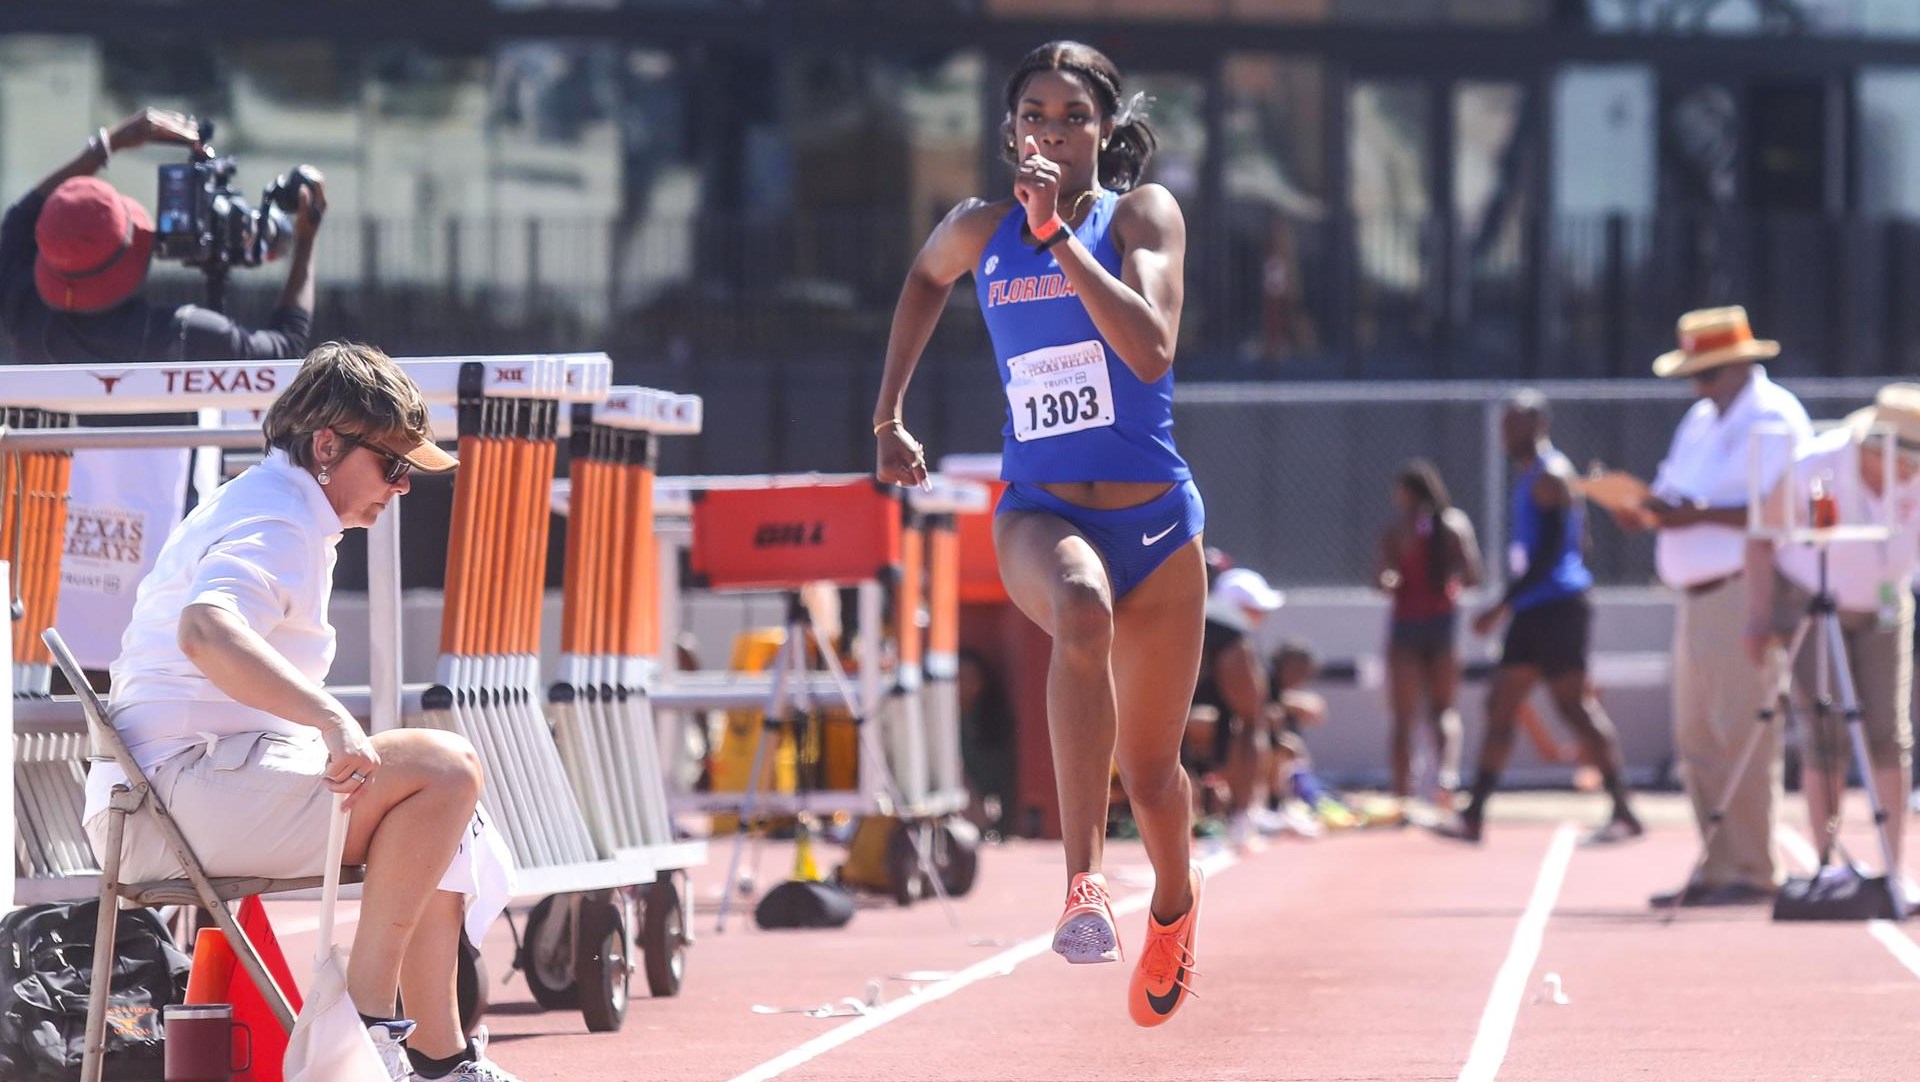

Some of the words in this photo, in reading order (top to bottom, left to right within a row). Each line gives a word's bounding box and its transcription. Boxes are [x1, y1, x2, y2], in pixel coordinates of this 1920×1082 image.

[988, 274, 1076, 308] FLORIDA
[161, 368, 276, 393] TEXAS
[1044, 376, 1074, 389] TRUIST
[1025, 385, 1100, 431] 1303
[69, 514, 143, 541] EXAS
[64, 537, 141, 565] ELAYS
